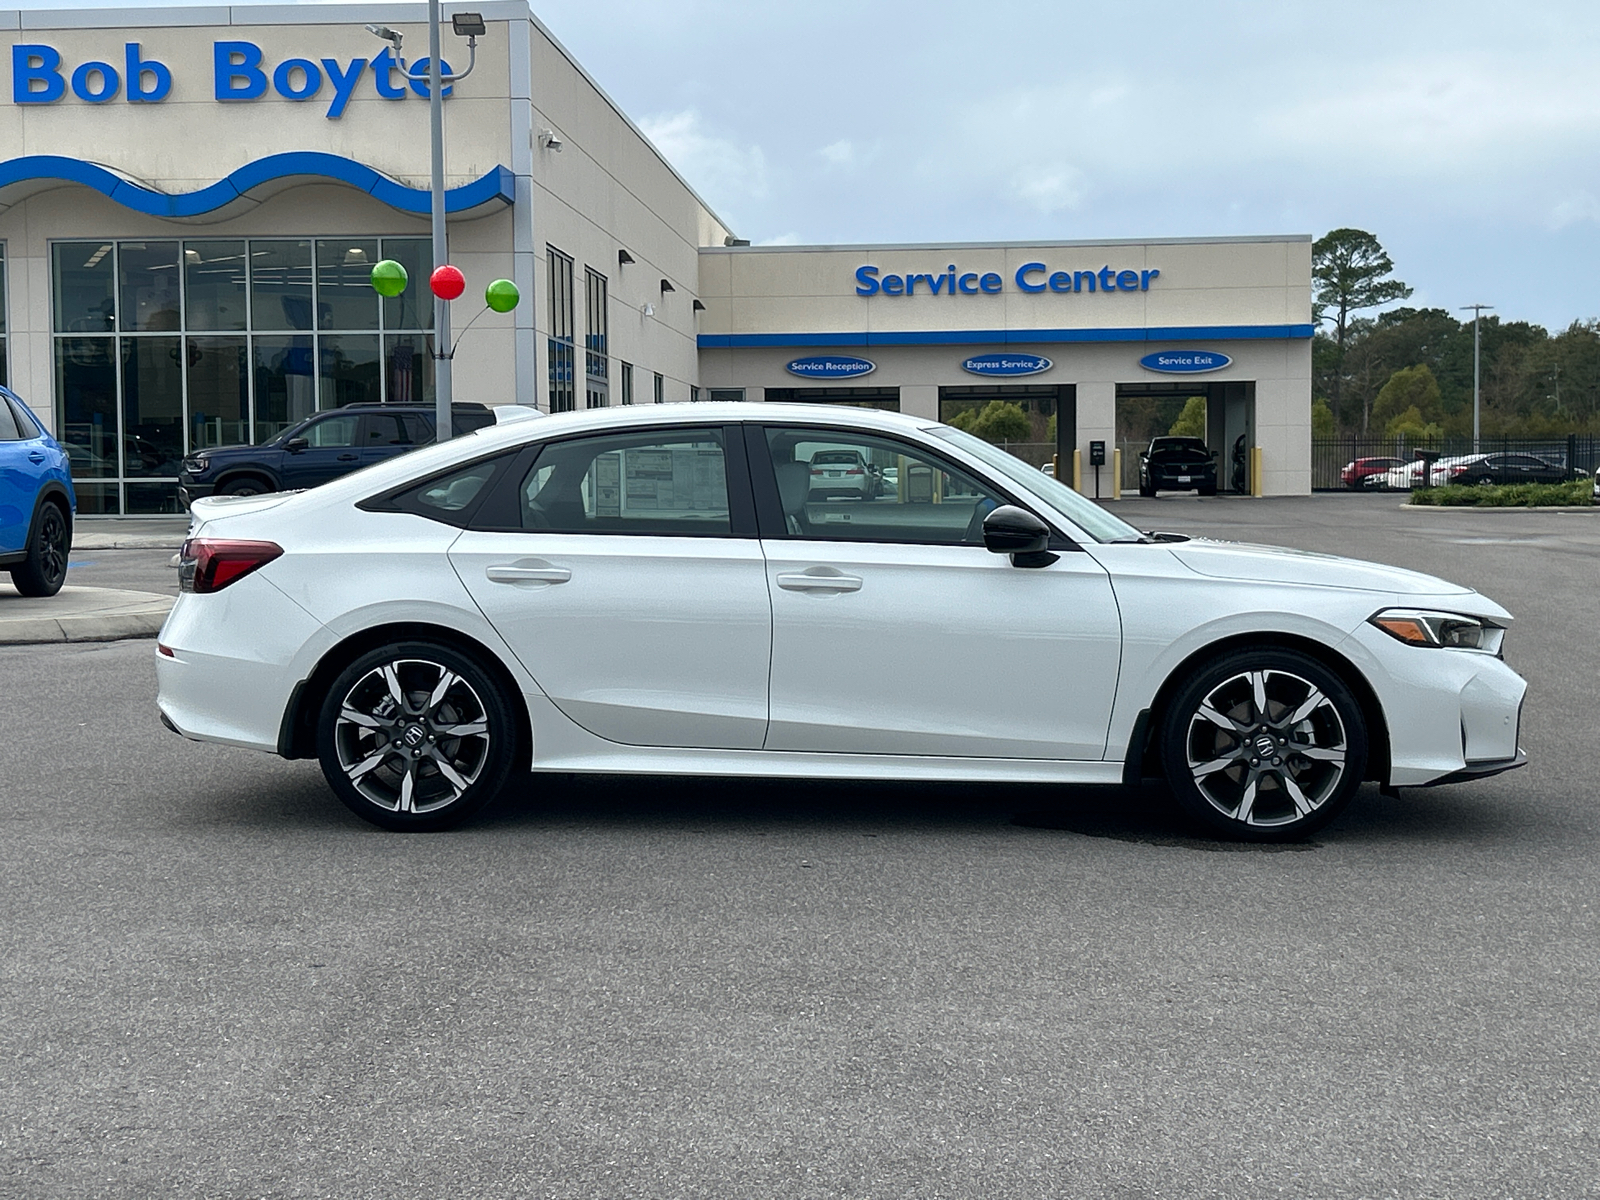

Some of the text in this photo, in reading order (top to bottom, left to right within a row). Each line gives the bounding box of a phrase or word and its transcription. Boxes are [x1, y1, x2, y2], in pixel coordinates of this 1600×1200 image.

[12, 41, 454, 119] Bob Boyte
[855, 262, 1160, 296] Service Center
[966, 360, 1034, 370] Express Service
[1158, 356, 1213, 365] Service Exit
[791, 362, 870, 372] Service Reception
